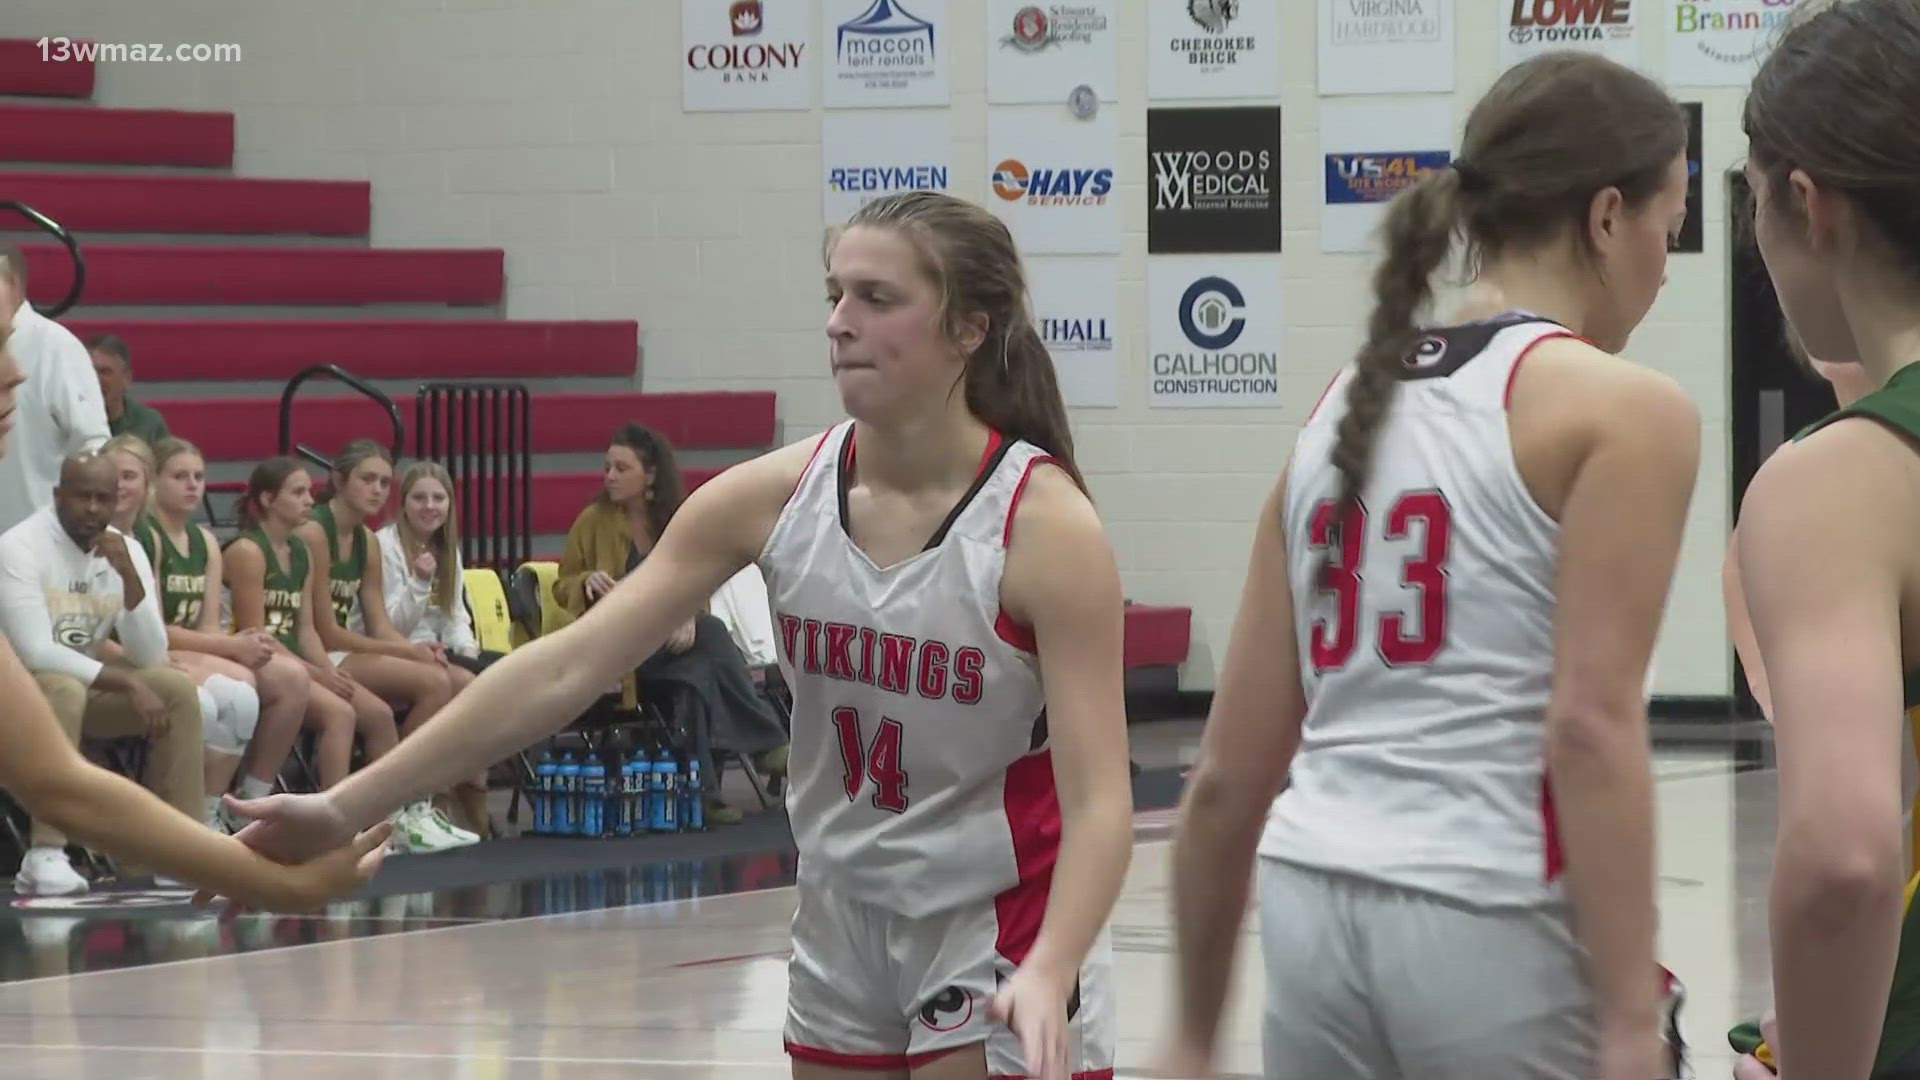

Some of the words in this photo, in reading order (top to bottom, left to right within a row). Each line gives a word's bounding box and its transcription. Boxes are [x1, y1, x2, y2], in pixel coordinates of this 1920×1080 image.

[1511, 0, 1630, 26] LOWE
[1536, 27, 1603, 41] TOYOTA
[847, 37, 924, 54] macon
[1170, 37, 1255, 52] CHEROKEE
[687, 42, 805, 71] COLONY
[848, 55, 874, 67] tent
[879, 53, 924, 66] rentals
[1189, 52, 1237, 64] BRICK
[723, 72, 768, 83] BANK
[829, 166, 947, 192] REGYMEN
[1028, 169, 1113, 196] HAYS
[1027, 195, 1107, 206] SERVICE
[1153, 352, 1277, 376] CALHOON
[1153, 378, 1277, 394] CONSTRUCTION
[1308, 488, 1451, 674] 33
[777, 611, 985, 705] VIKINGS
[832, 705, 908, 815] 14
